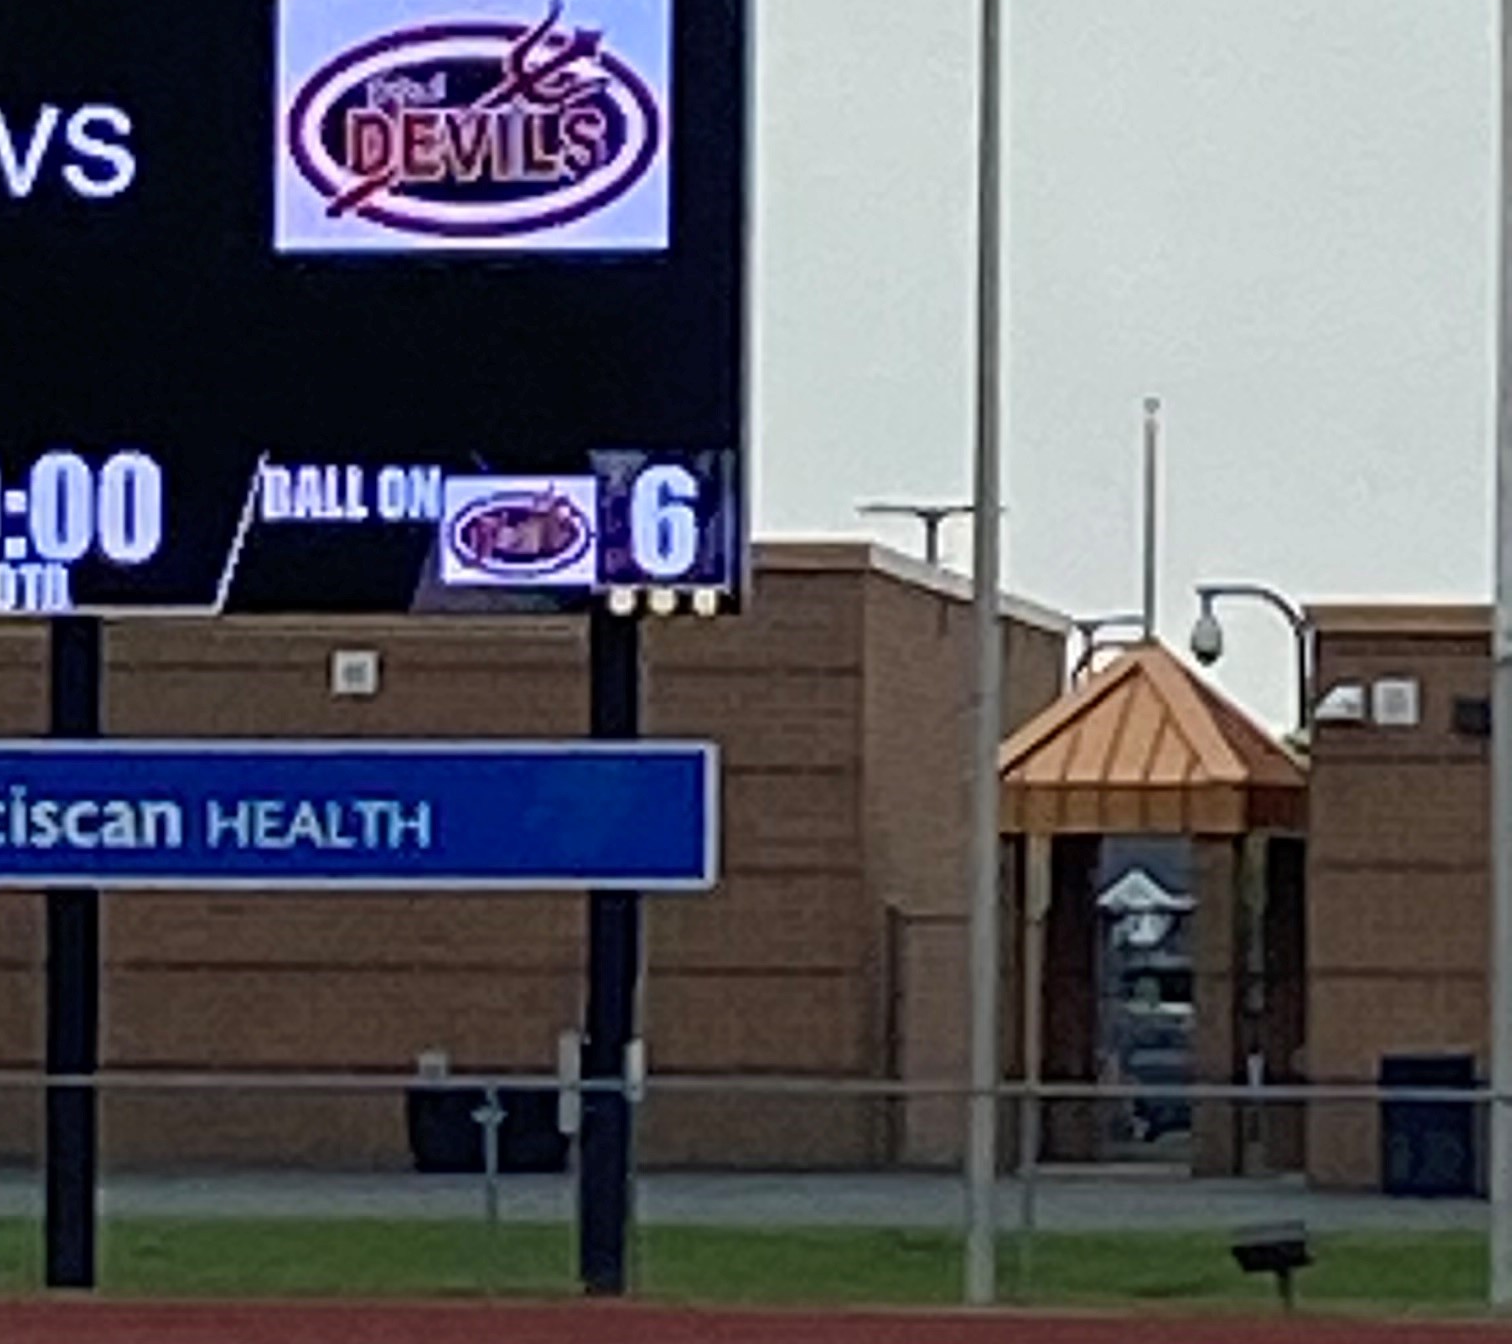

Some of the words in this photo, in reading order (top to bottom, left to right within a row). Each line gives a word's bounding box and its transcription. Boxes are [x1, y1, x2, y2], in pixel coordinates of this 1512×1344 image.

[346, 106, 607, 183] DEVILS
[377, 466, 442, 520] ON
[630, 464, 700, 578] 6
[207, 801, 431, 848] HEALTH
